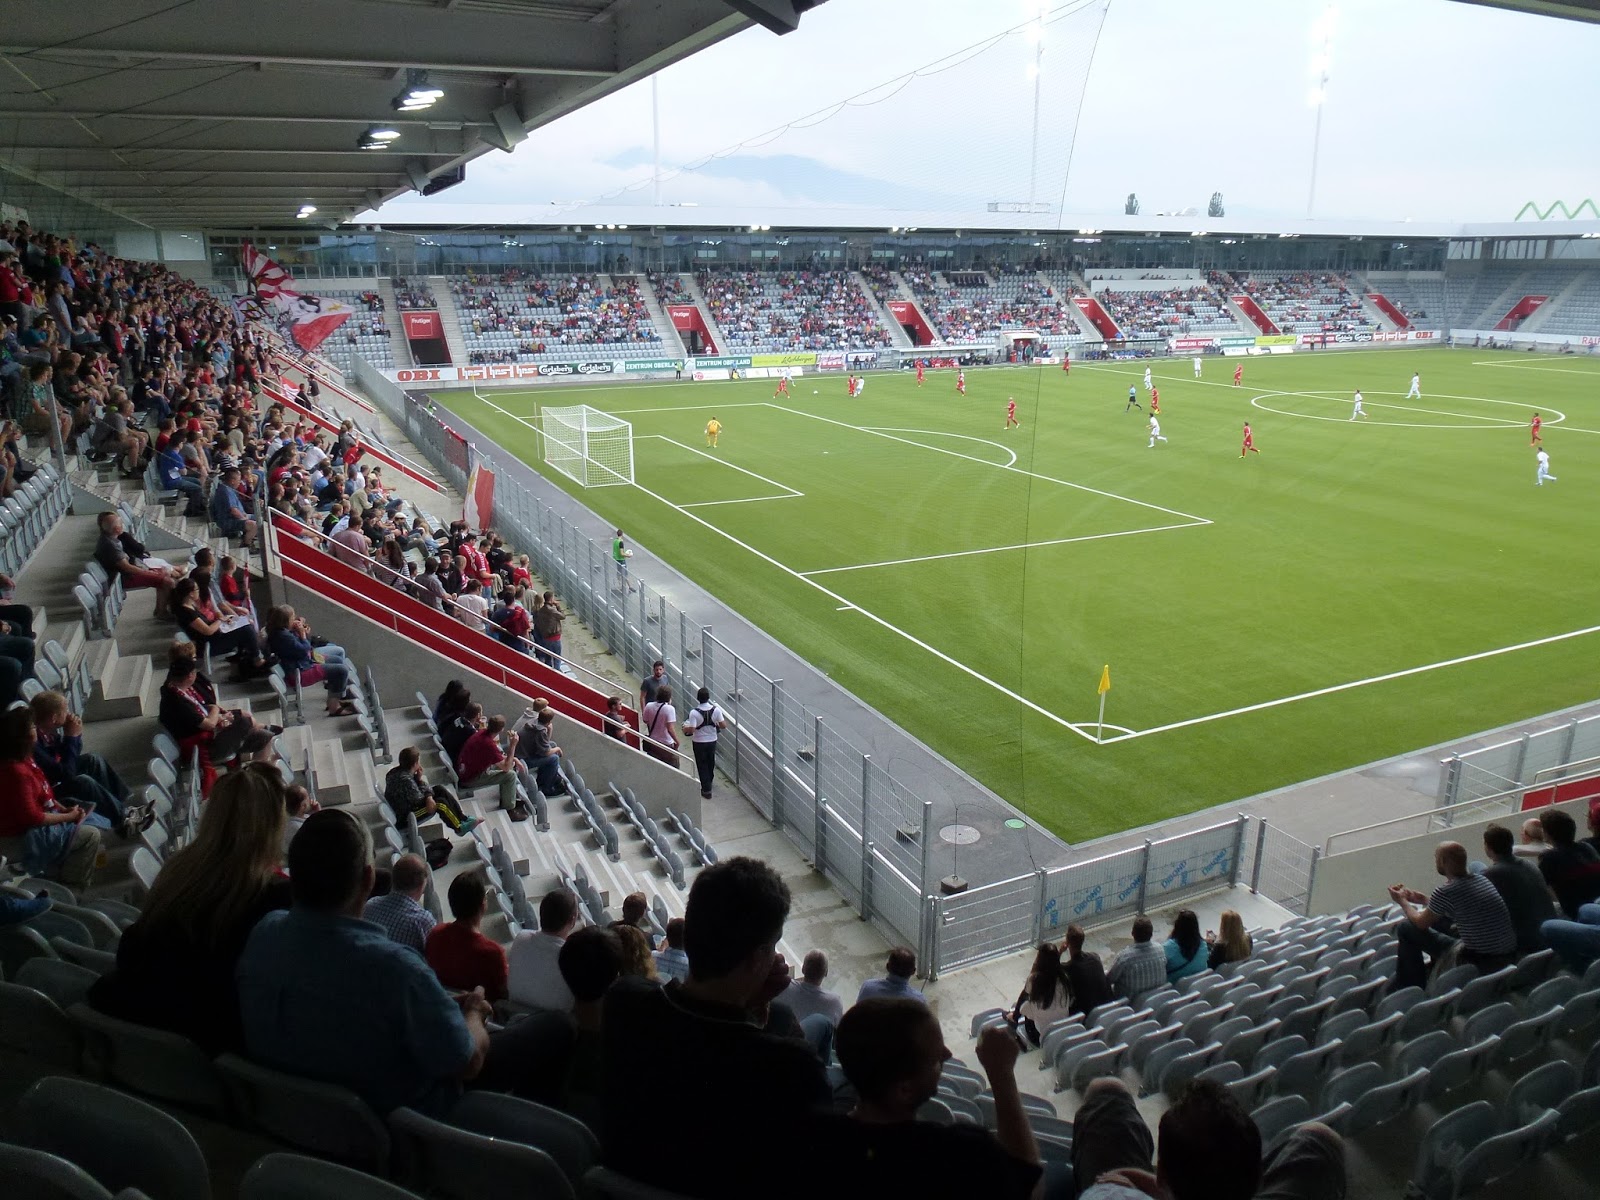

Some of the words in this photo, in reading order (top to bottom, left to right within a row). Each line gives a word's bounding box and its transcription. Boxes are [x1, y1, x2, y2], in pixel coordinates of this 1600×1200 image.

[1415, 331, 1434, 339] OBI
[539, 364, 573, 376] Carlsberg
[578, 362, 611, 375] Carlsberg
[625, 362, 653, 370] ZENTRUM
[653, 361, 683, 369] OBERLAD
[397, 370, 440, 382] OBI
[1119, 874, 1143, 901] DIBON
